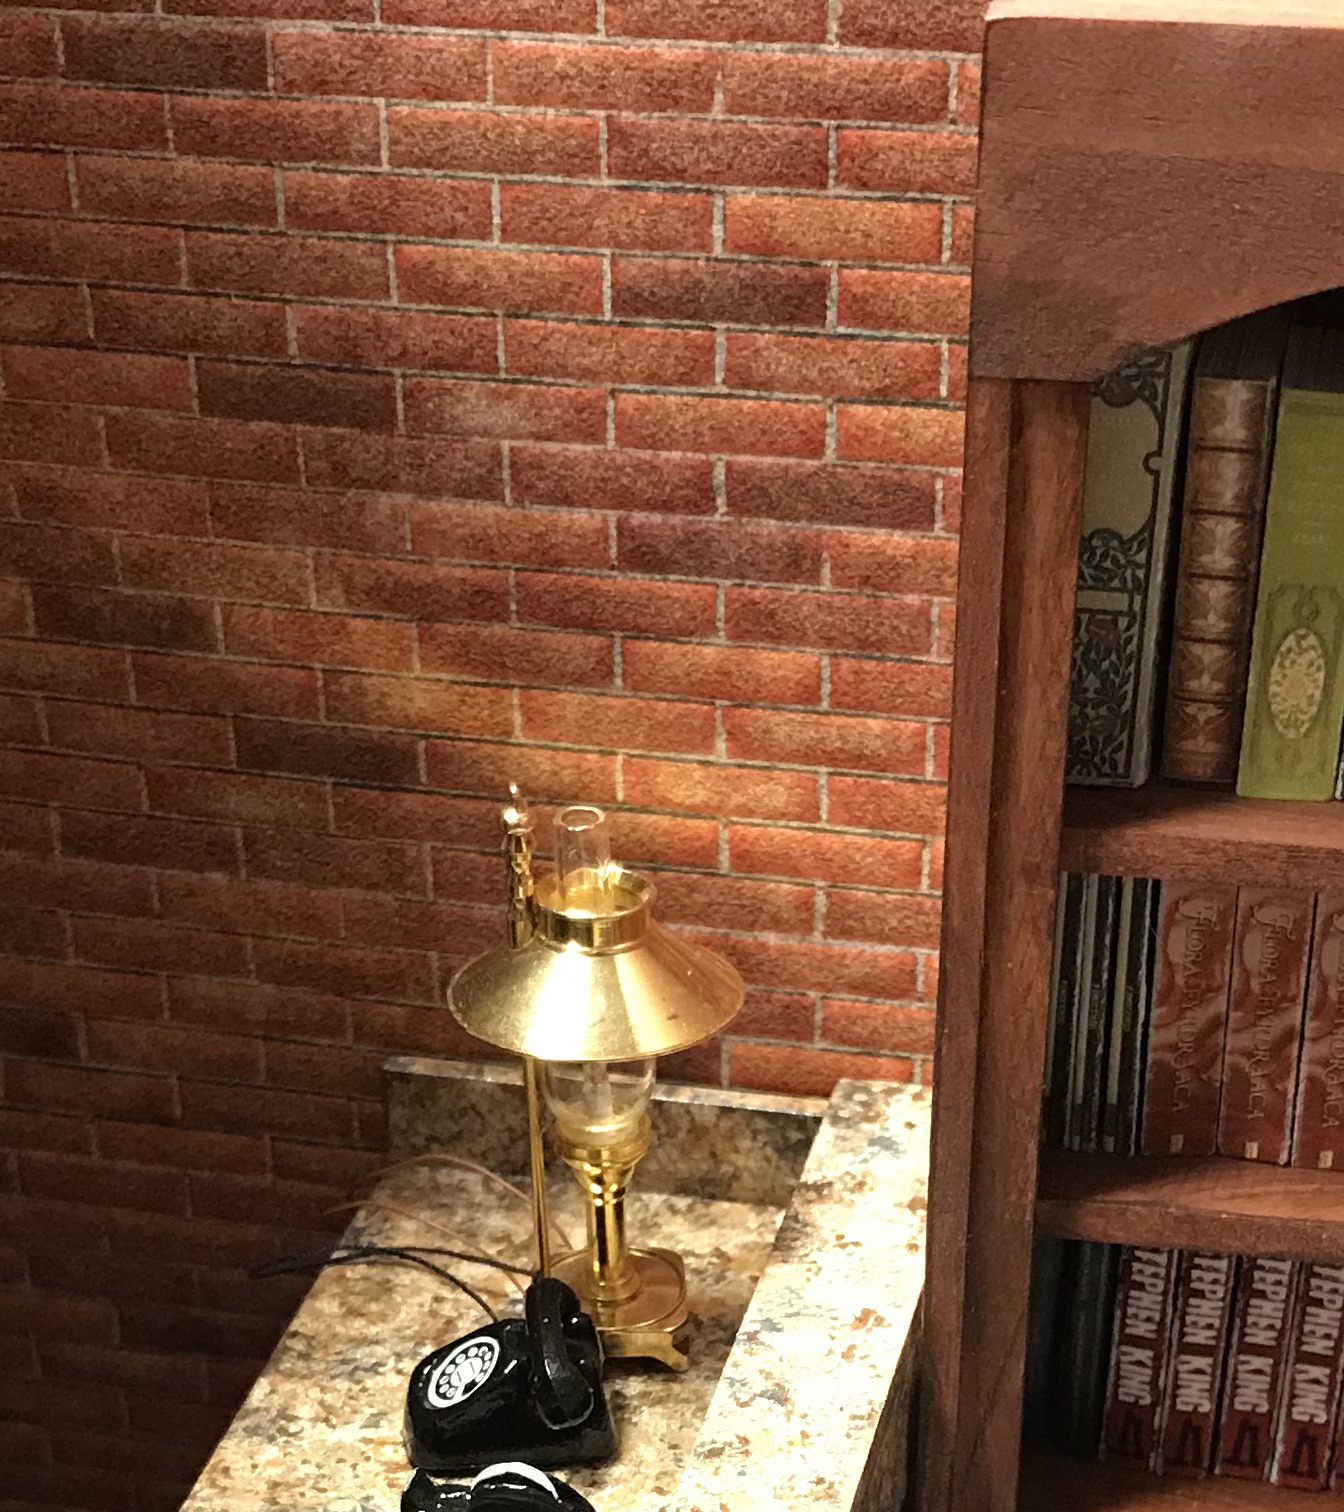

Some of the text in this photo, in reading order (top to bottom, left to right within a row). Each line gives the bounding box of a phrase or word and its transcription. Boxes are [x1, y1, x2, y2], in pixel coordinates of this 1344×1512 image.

[1118, 1250, 1168, 1407] TEPHEN KING
[1175, 1255, 1228, 1414] TEPHEN KING
[1233, 1259, 1292, 1414] TEPHEN KING
[1291, 1364, 1330, 1424] KING
